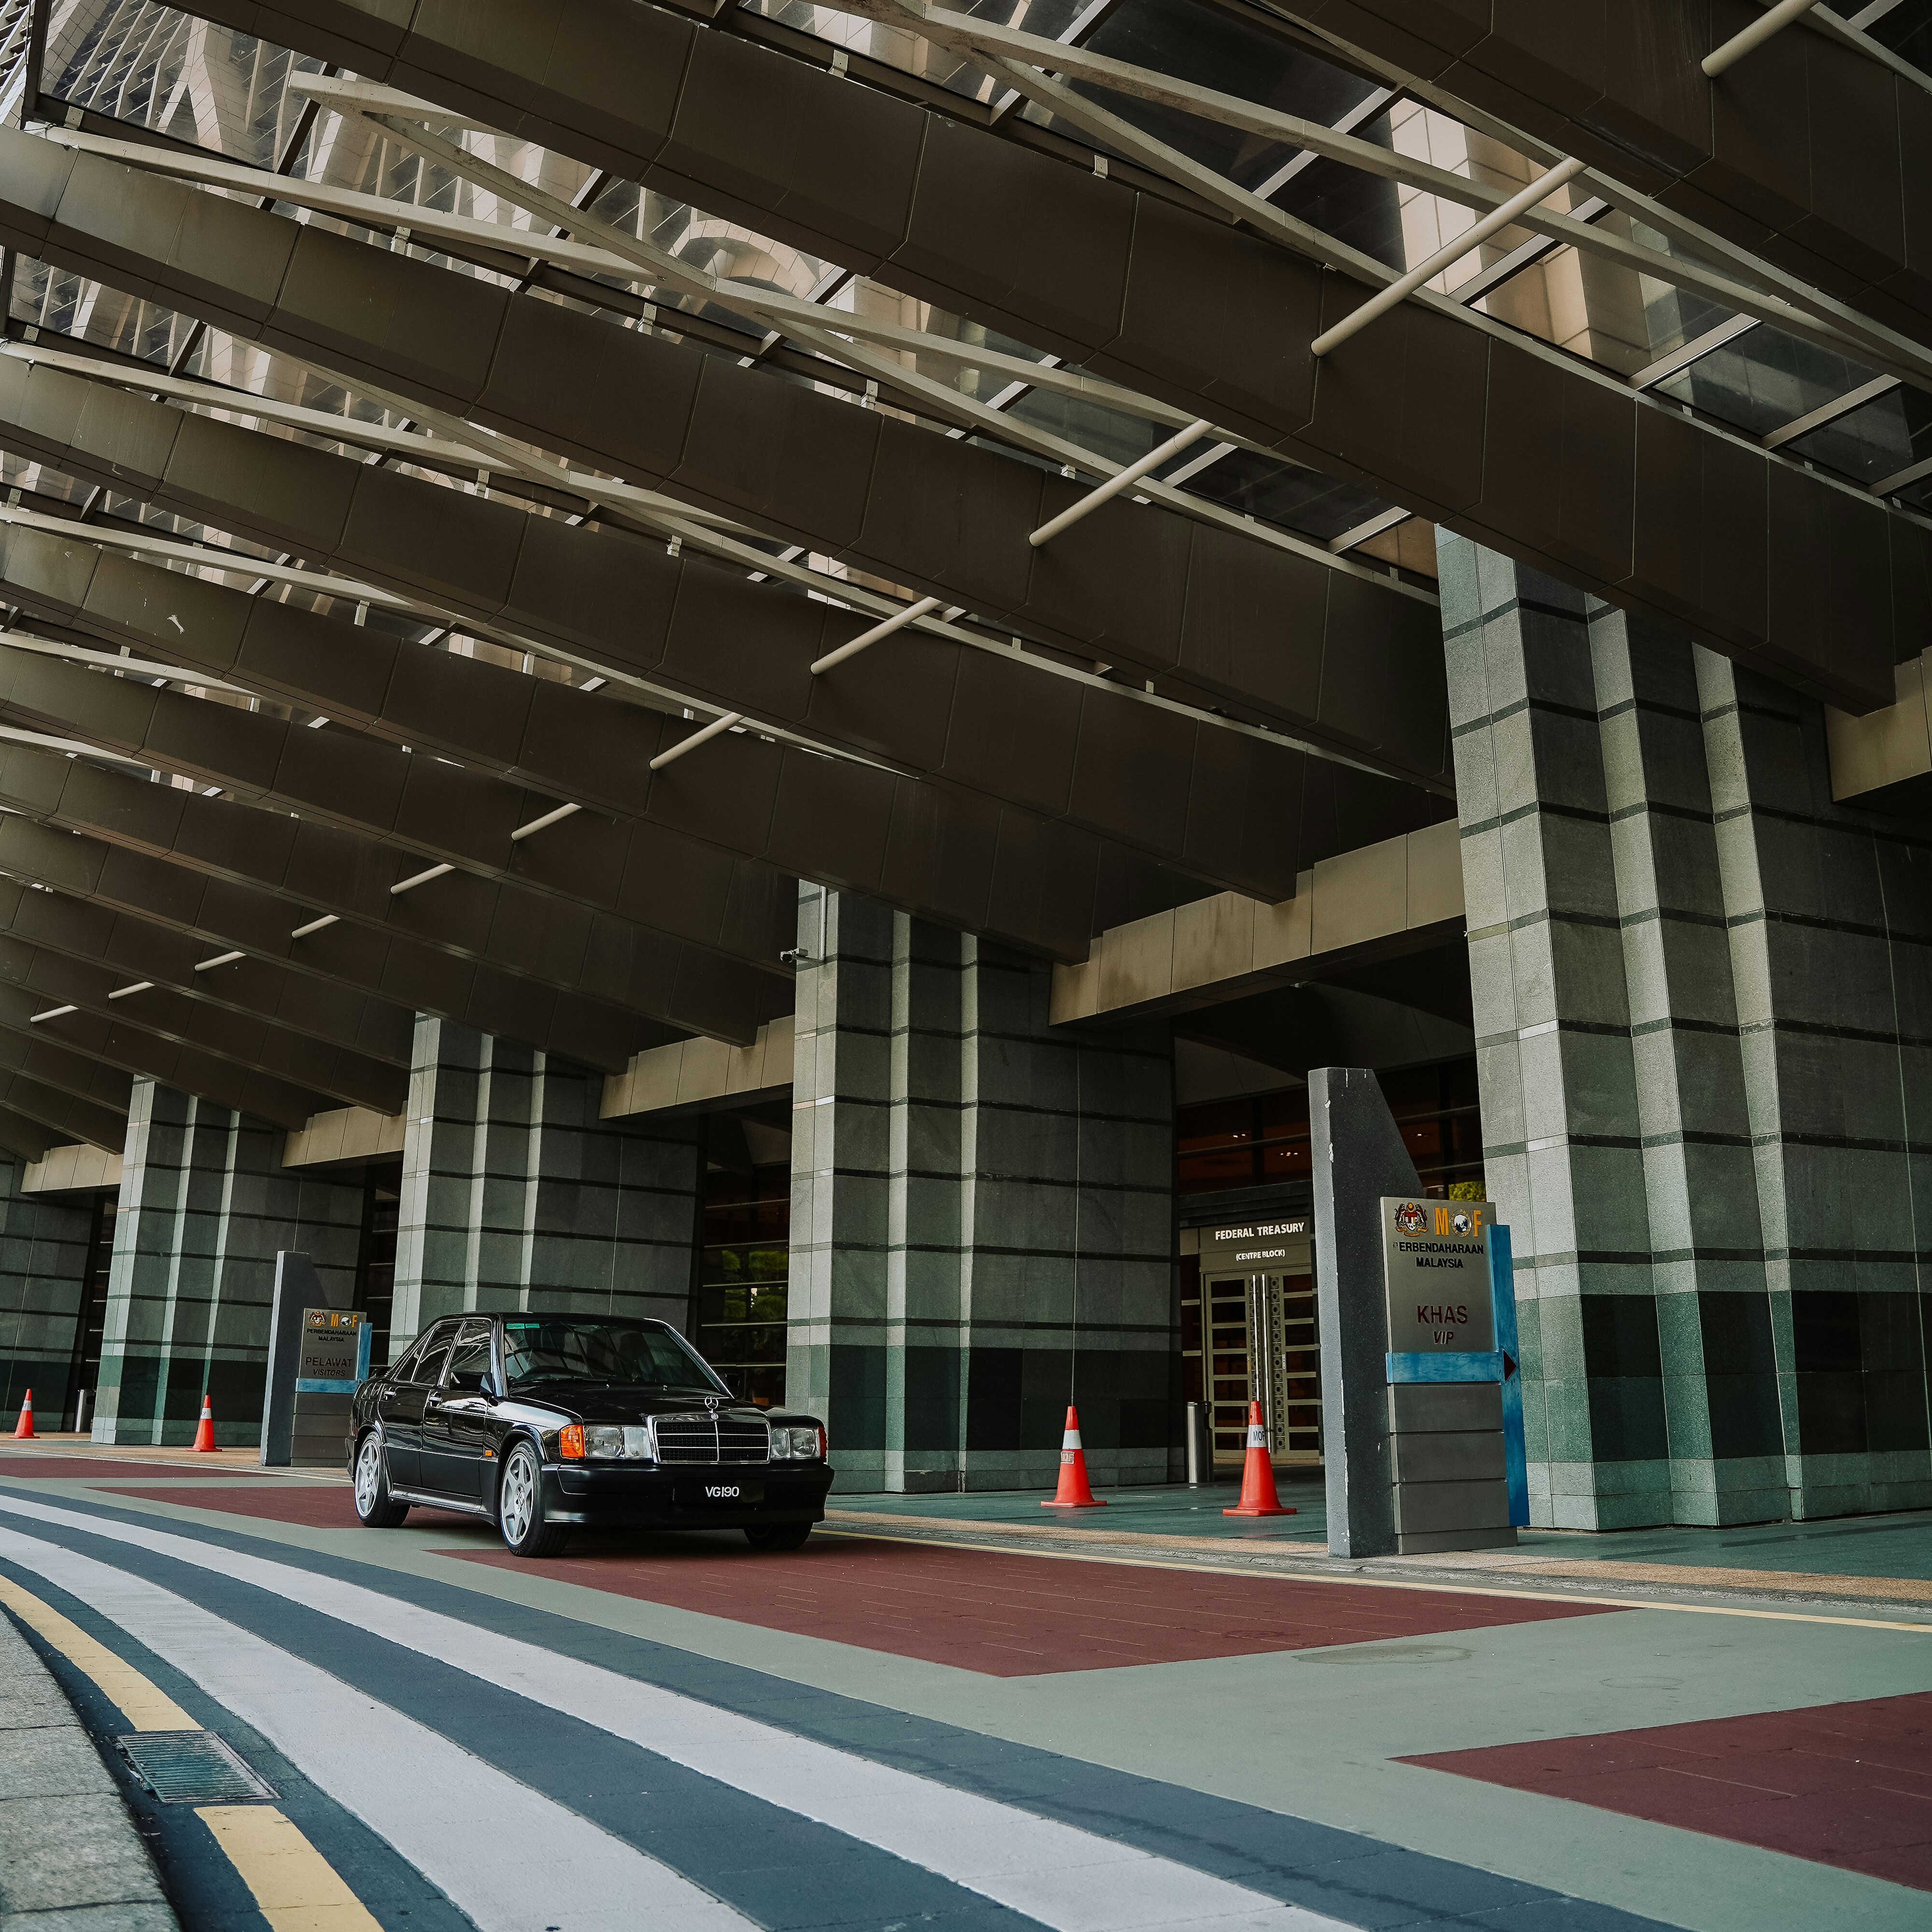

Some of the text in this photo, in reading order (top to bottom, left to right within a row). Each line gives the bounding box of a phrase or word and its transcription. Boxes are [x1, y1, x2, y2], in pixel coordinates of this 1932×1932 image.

[1215, 1222, 1305, 1240] FEDERAL TREASURY
[1236, 1250, 1285, 1261] (CENTRE BLOCK)
[1416, 1257, 1464, 1268] MALAYSIA
[1417, 1305, 1468, 1323] KHAS
[1433, 1331, 1454, 1345] VIP
[305, 1357, 353, 1367] PELAWAT
[1253, 1430, 1265, 1441] MOF
[705, 1486, 739, 1497] VG190
